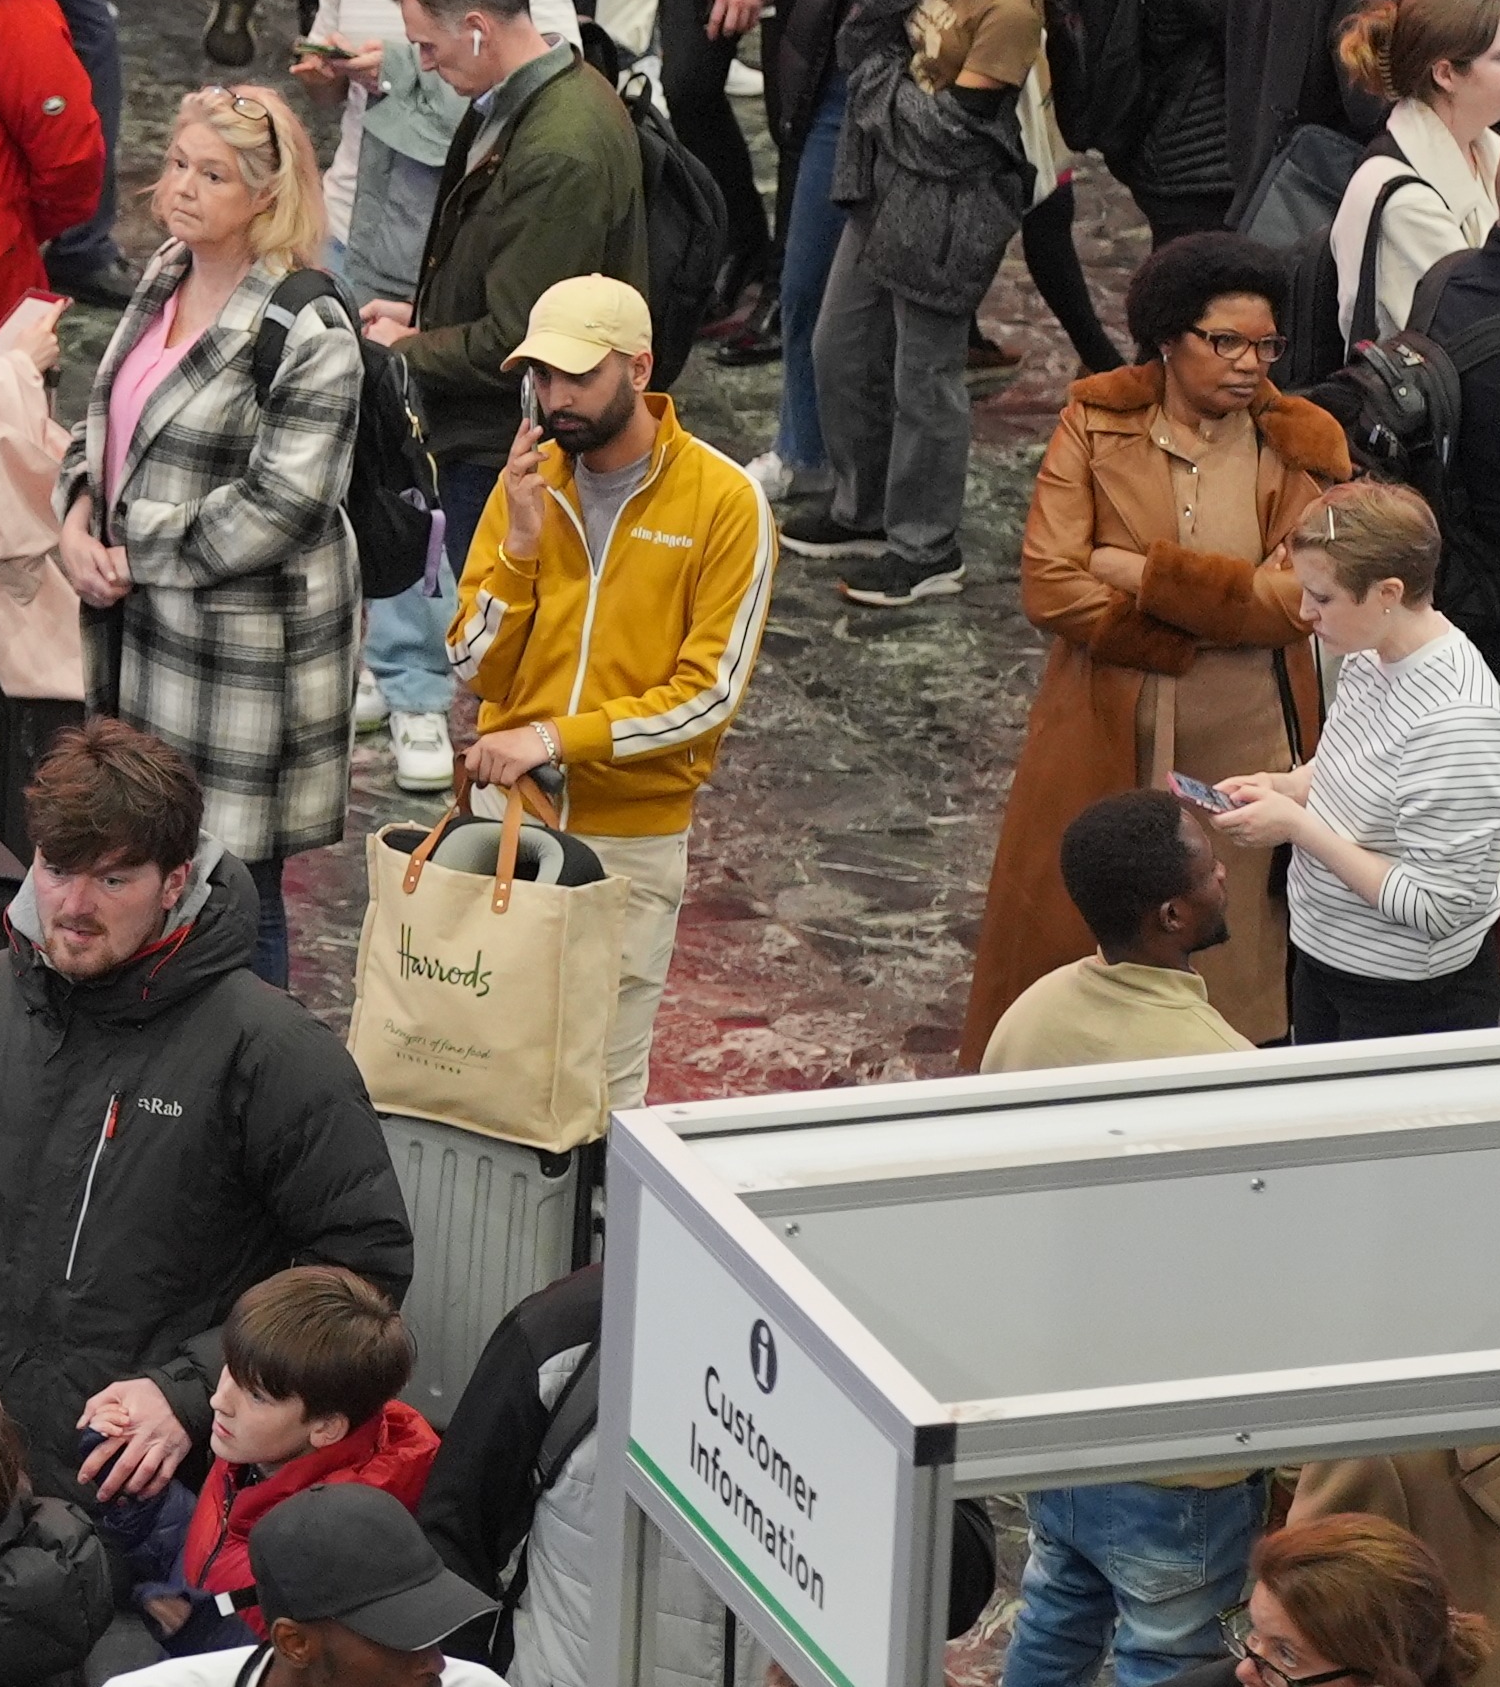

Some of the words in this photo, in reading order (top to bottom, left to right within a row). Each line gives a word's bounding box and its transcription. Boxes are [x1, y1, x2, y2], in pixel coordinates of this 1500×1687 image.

[630, 526, 652, 542] alm
[396, 922, 493, 998] Harrods
[150, 1097, 183, 1118] Rab
[704, 1365, 819, 1521] Customer
[689, 1421, 825, 1612] Information
